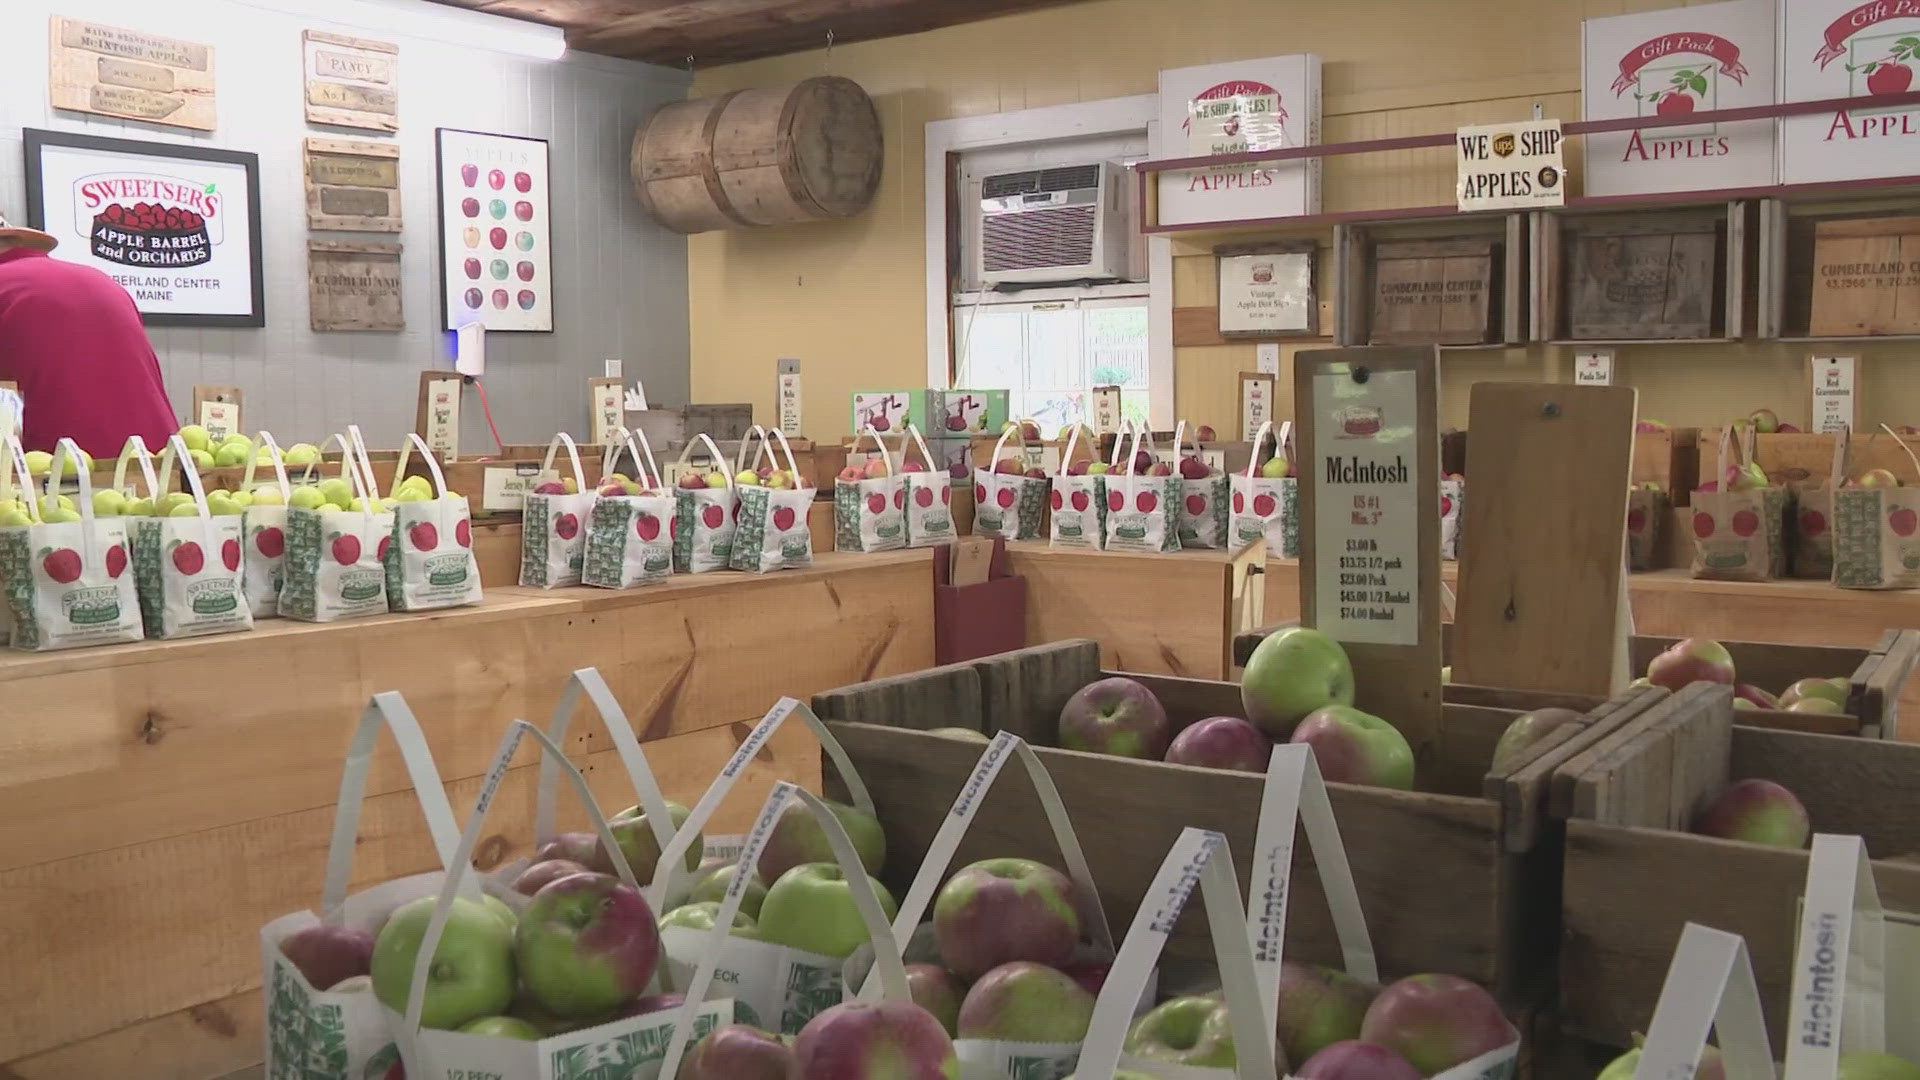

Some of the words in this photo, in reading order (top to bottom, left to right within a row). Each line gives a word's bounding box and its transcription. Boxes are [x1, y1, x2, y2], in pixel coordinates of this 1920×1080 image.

[1851, 2, 1887, 27] Gift
[1893, 0, 1920, 15] Pa
[1641, 37, 1671, 60] Gift
[1677, 36, 1715, 53] Pack
[149, 50, 192, 65] APPLES
[1210, 103, 1230, 117] SHIP
[1232, 99, 1266, 113] ALES
[1823, 110, 1920, 142] APPL
[1460, 134, 1489, 161] WE
[1494, 136, 1515, 156] ups
[1521, 129, 1560, 157] SHIP
[1622, 129, 1730, 162] APPLES
[1188, 170, 1273, 192] APPLES
[1464, 171, 1532, 199] APPLES
[96, 227, 144, 248] APPLE
[151, 232, 207, 249] BARREL
[97, 243, 124, 259] and
[128, 247, 207, 264] ORCHARDS
[1821, 262, 1905, 276] CUMBERLAND
[112, 274, 170, 288] BERLAND
[174, 277, 221, 290] CENTER
[1380, 281, 1443, 295] CUMBERLAND
[1446, 280, 1483, 291] CENTER
[136, 289, 173, 301] MAINE
[1250, 289, 1276, 299] Vintage
[1326, 455, 1408, 485] McIntosh
[1353, 495, 1366, 509] US
[1367, 496, 1379, 509] #1
[1346, 539, 1369, 552] $3.00
[1340, 557, 1367, 569] $13.75
[1369, 557, 1383, 569] 1/2
[1340, 573, 1367, 586] $23.00
[1369, 574, 1386, 586] Peck
[1340, 590, 1368, 603] $45.00
[1370, 591, 1383, 603] 1/2
[1385, 591, 1410, 604] Bushel
[1340, 607, 1368, 620] $74.00
[1369, 607, 1394, 620] Bushel
[729, 785, 790, 897] McIntosh
[1255, 845, 1289, 962] McIntosh
[713, 969, 740, 984] ECK
[1802, 912, 1838, 1048] McIntosh
